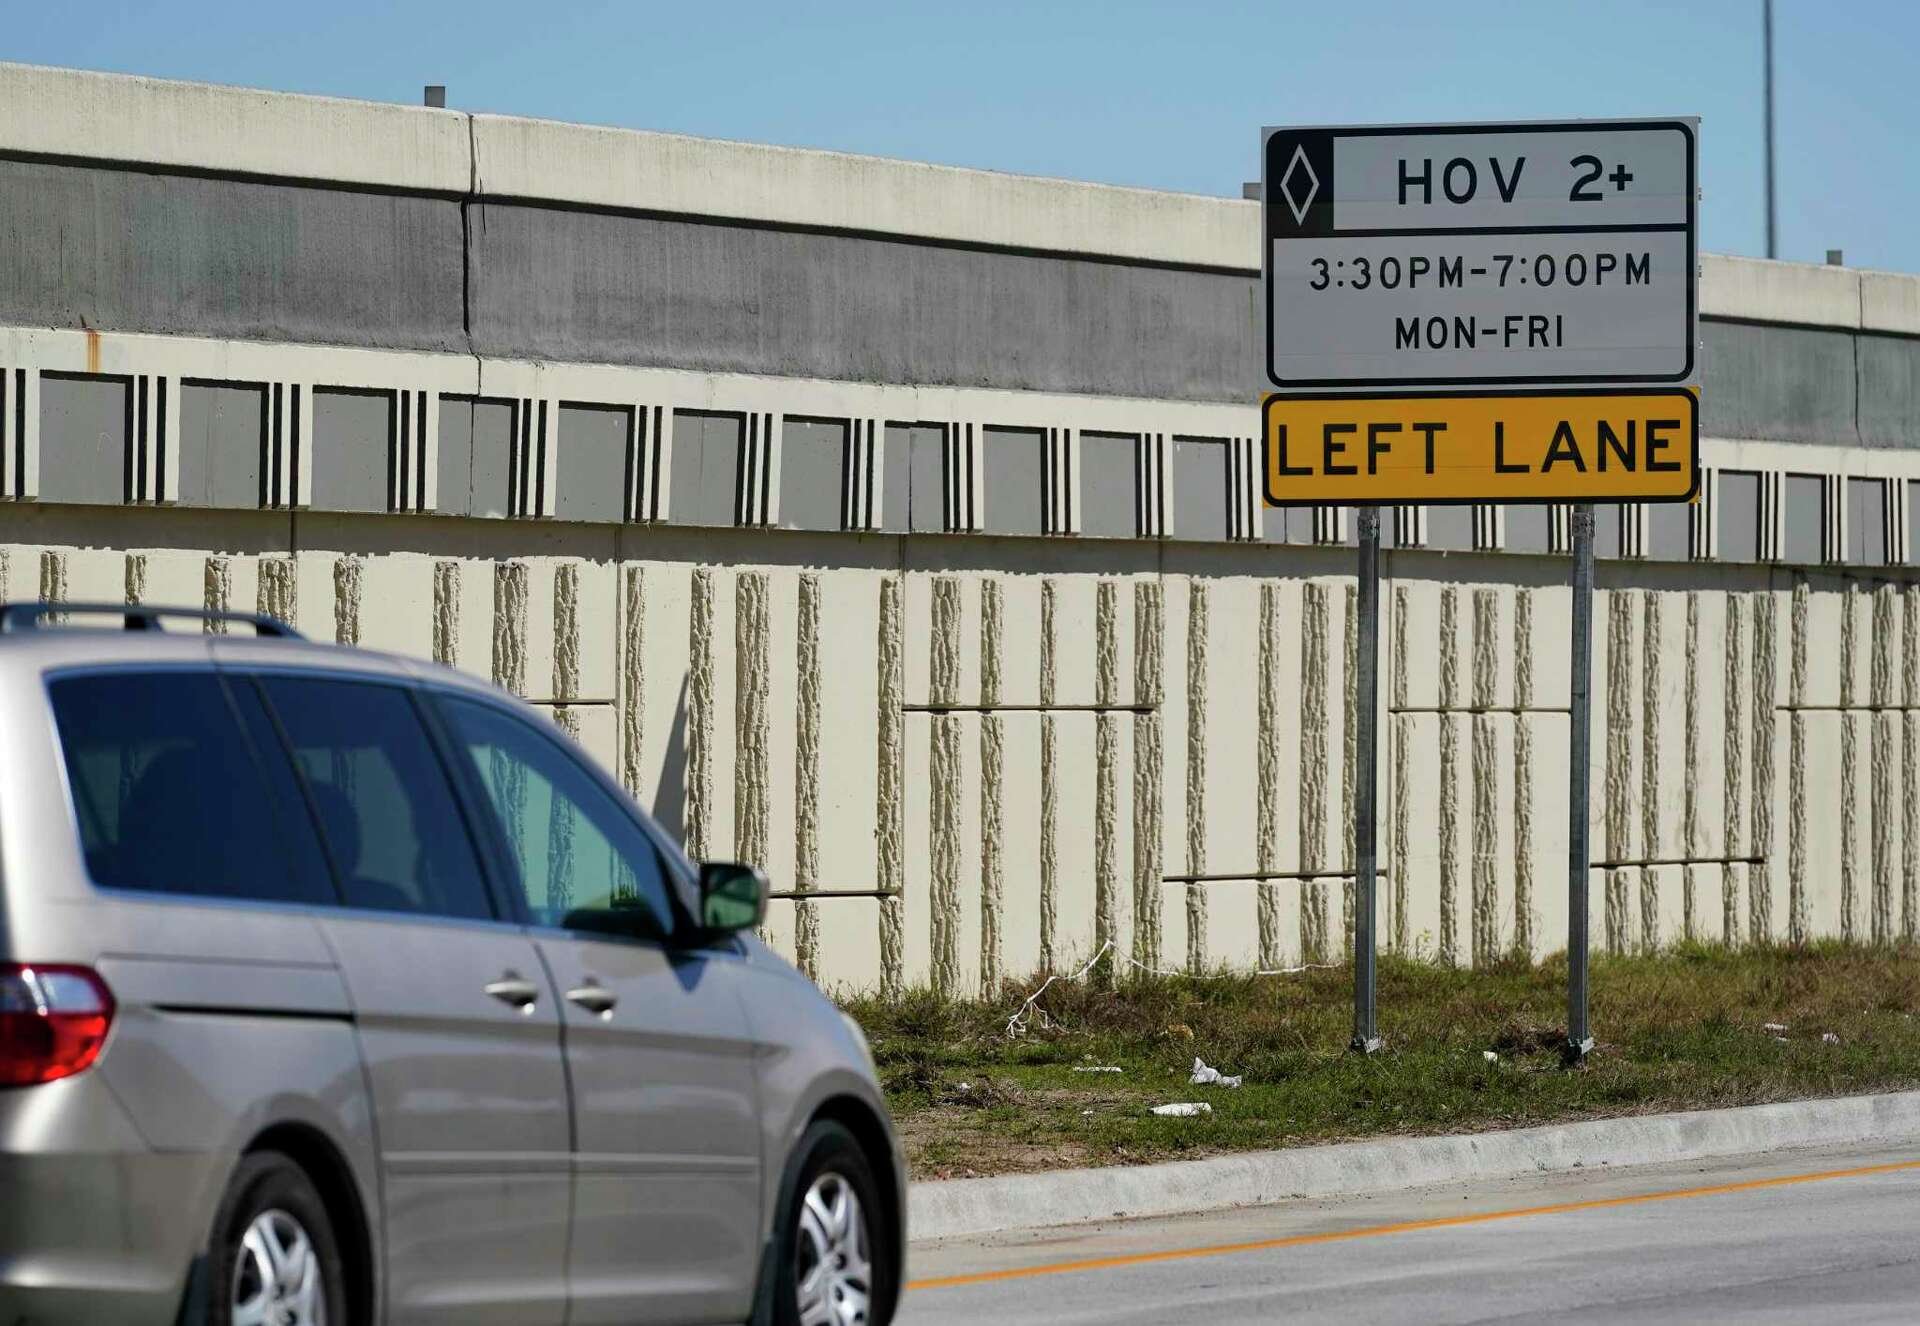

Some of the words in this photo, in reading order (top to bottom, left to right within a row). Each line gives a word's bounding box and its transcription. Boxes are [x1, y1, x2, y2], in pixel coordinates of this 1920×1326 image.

[1397, 156, 1526, 205] HOV
[1568, 154, 1634, 202] 2+
[1309, 252, 1651, 291] 3:30PM-7:00PM
[1395, 314, 1563, 351] MON-FRI
[1278, 422, 1448, 477] LEFT
[1494, 419, 1682, 475] LANE
